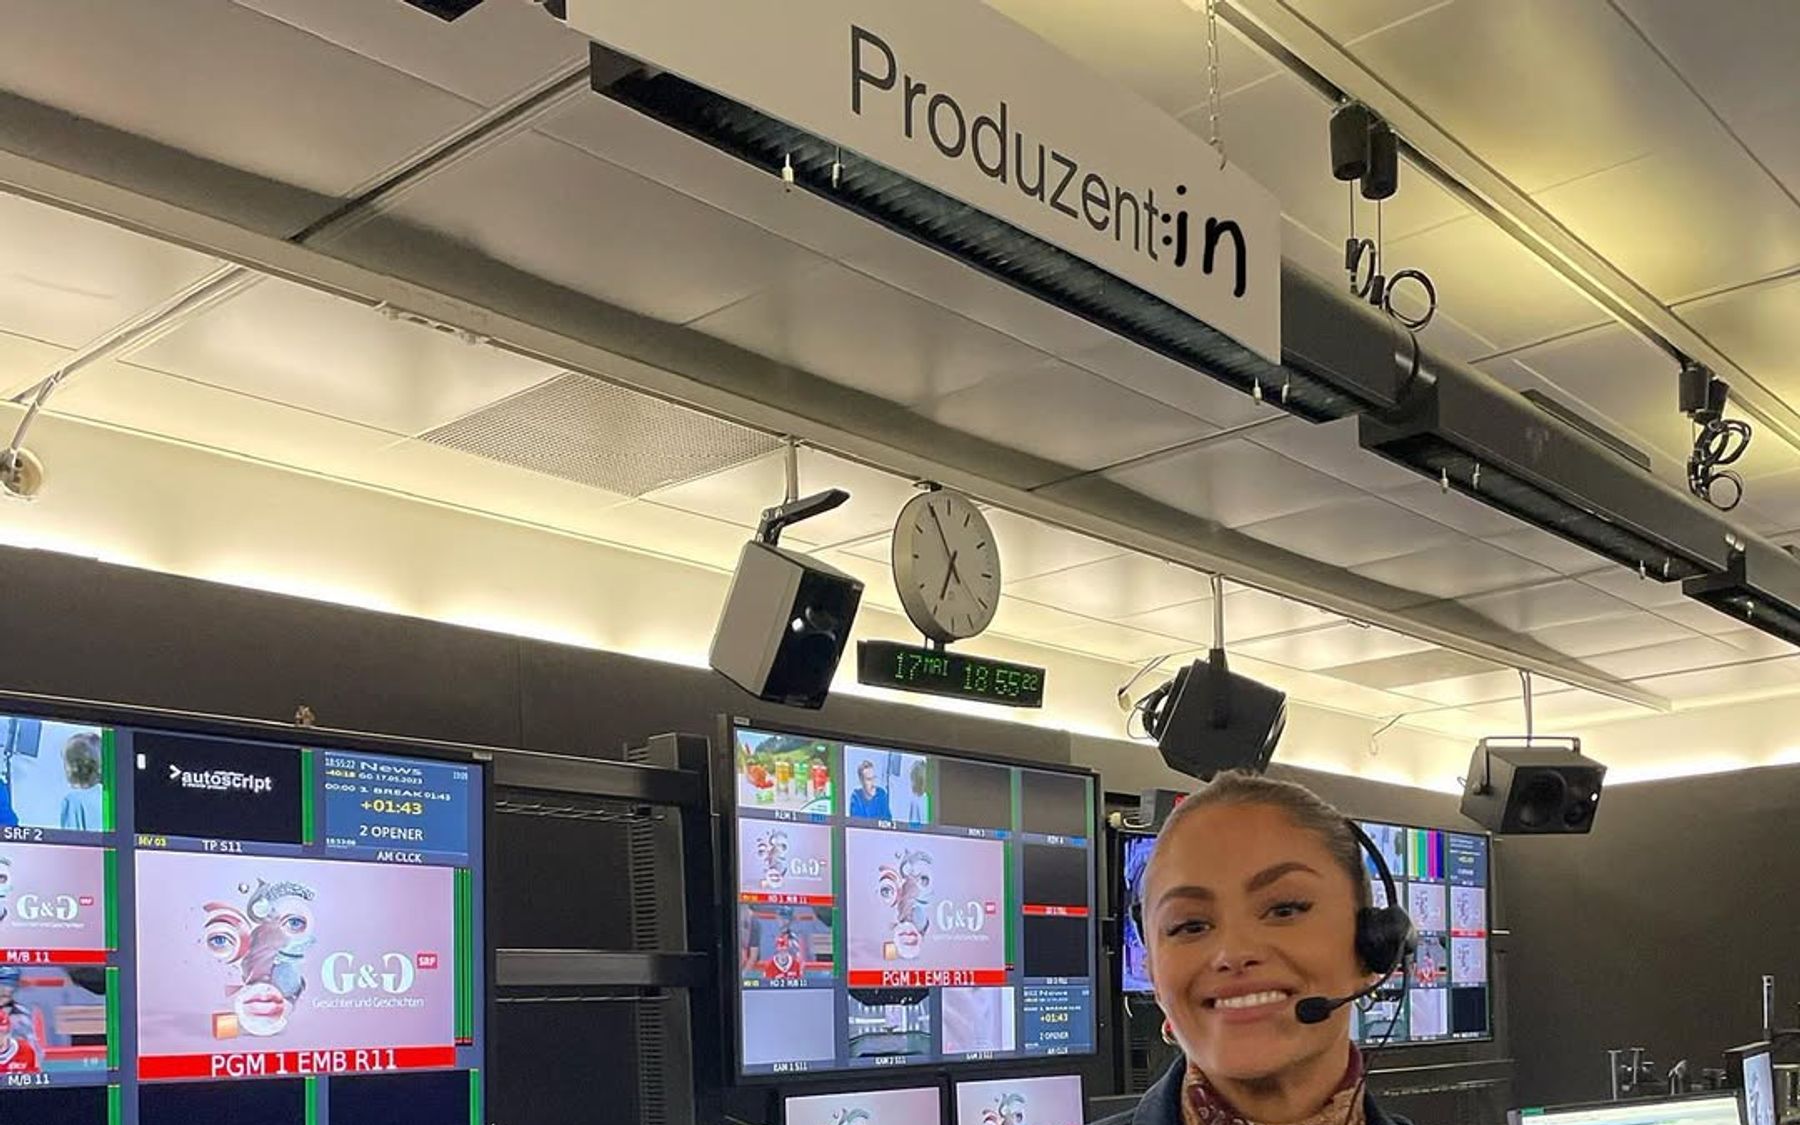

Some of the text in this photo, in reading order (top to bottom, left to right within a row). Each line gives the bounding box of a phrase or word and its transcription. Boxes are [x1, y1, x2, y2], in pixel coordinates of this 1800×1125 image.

[851, 24, 1247, 298] Produzent:in
[895, 652, 922, 680] 17
[923, 657, 948, 676] MAI
[964, 663, 988, 692] 18
[1022, 673, 1039, 692] 22
[361, 762, 422, 775] News
[373, 787, 423, 798] BREAK
[360, 799, 423, 815] +01:43
[4, 826, 43, 841] SRF 2
[359, 825, 424, 841] 2 OPENER
[202, 839, 243, 852] TP S11
[377, 851, 422, 863] AM CLCK
[6, 950, 51, 962] M/B 11
[882, 971, 975, 986] PGM 1 EMB R11
[211, 1049, 397, 1077] PGM 1 EMB R11
[8, 1073, 50, 1086] M/B 11
